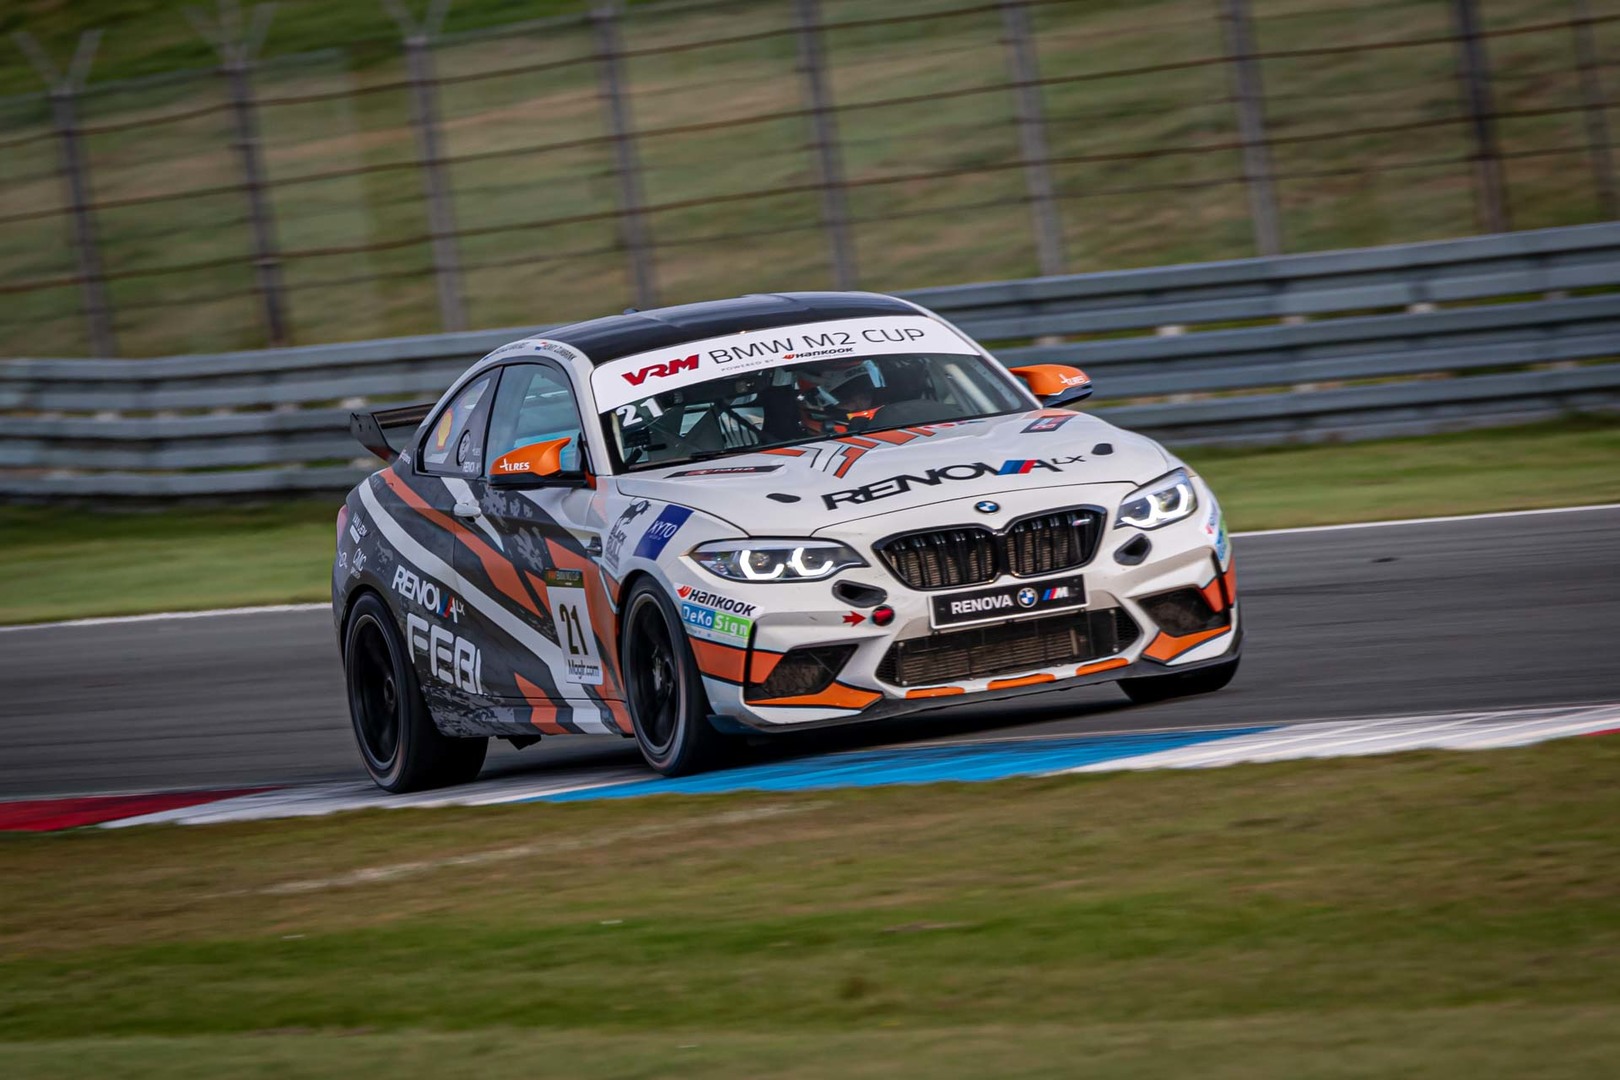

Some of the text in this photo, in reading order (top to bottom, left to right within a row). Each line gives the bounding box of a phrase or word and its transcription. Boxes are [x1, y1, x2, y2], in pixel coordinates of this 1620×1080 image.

[708, 328, 925, 364] BMW M2 CUP
[621, 354, 699, 386] VRM
[721, 361, 762, 372] POWERED
[615, 397, 664, 427] 21
[821, 455, 1086, 511] RENOVA LX
[392, 564, 458, 623] RENOVA
[951, 594, 1014, 615] RENOVA
[559, 603, 589, 656] 21
